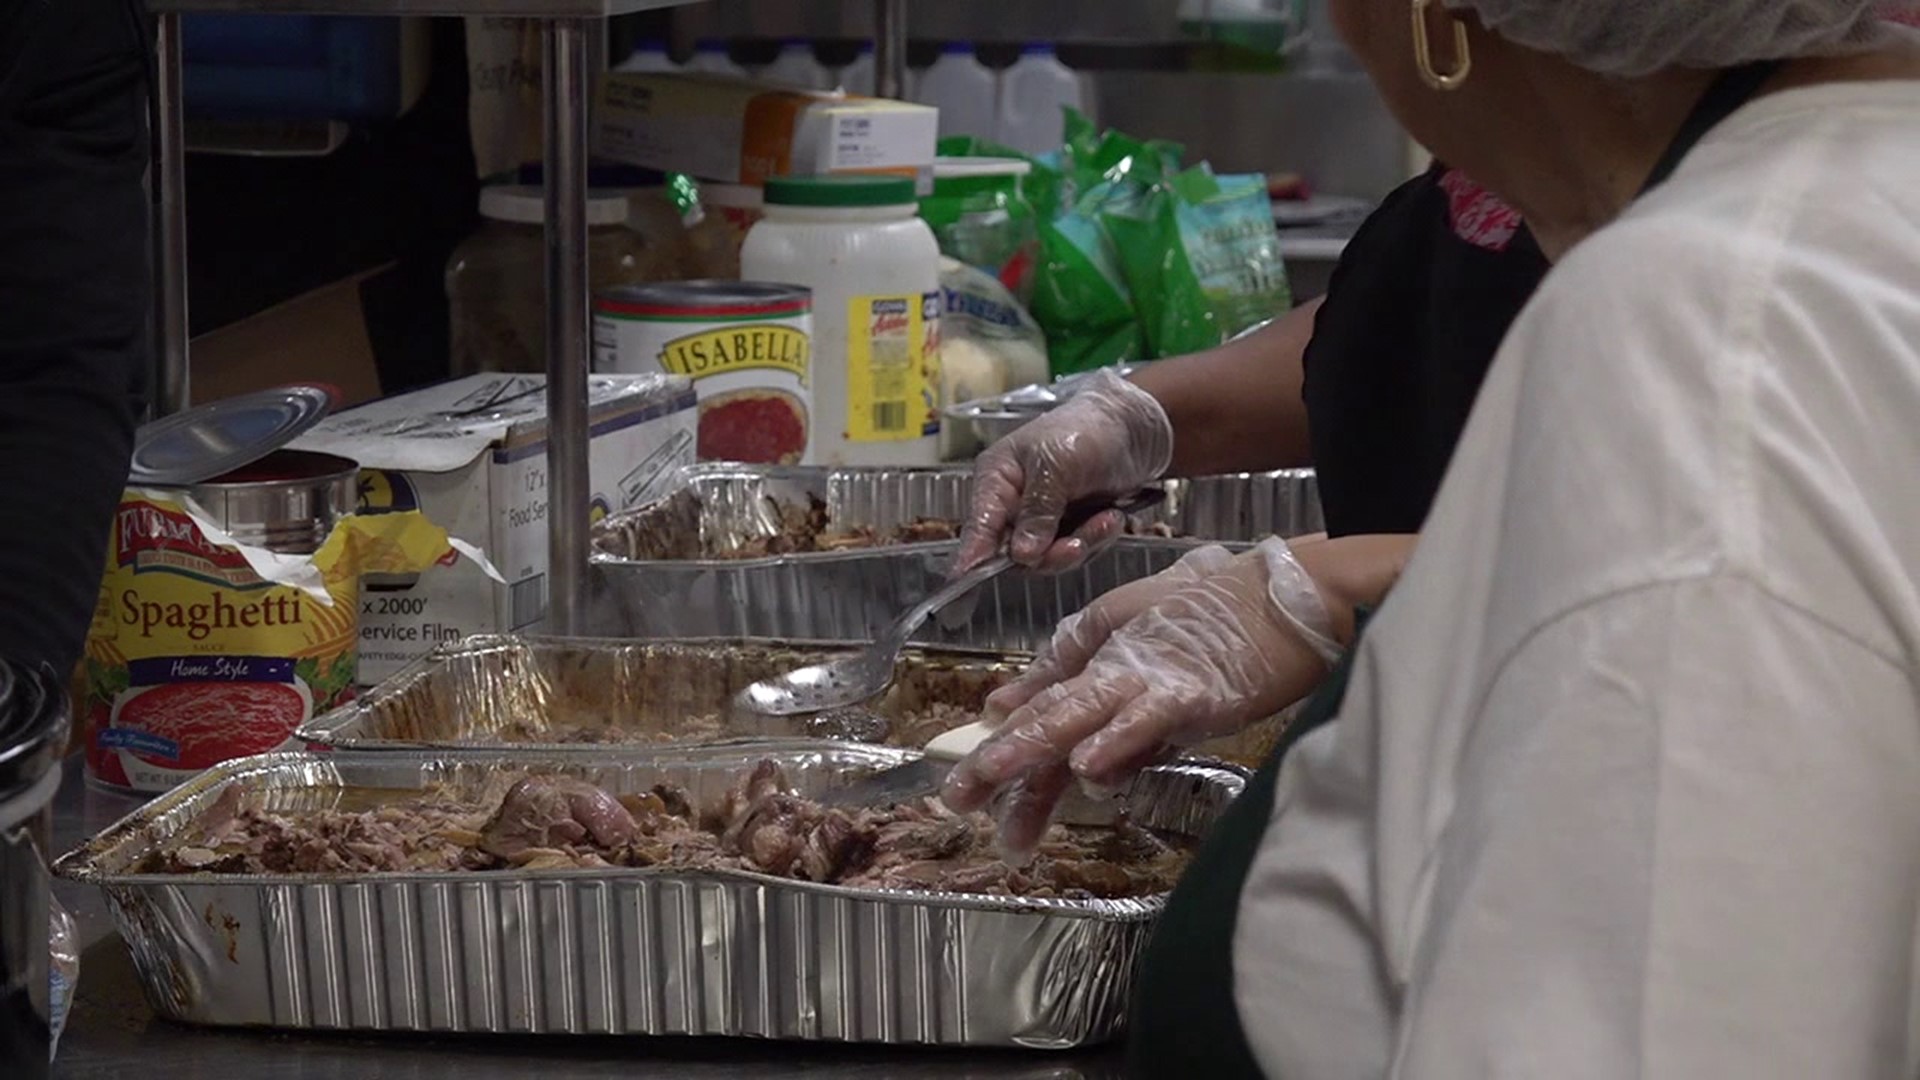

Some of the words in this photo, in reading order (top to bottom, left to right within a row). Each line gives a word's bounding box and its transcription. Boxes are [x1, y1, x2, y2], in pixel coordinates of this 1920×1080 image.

[509, 502, 531, 528] Food
[122, 589, 303, 640] Spaghetti
[362, 601, 373, 614] x
[360, 623, 417, 641] ervice
[423, 623, 460, 642] Film
[171, 658, 209, 677] Home
[213, 656, 249, 680] Style
